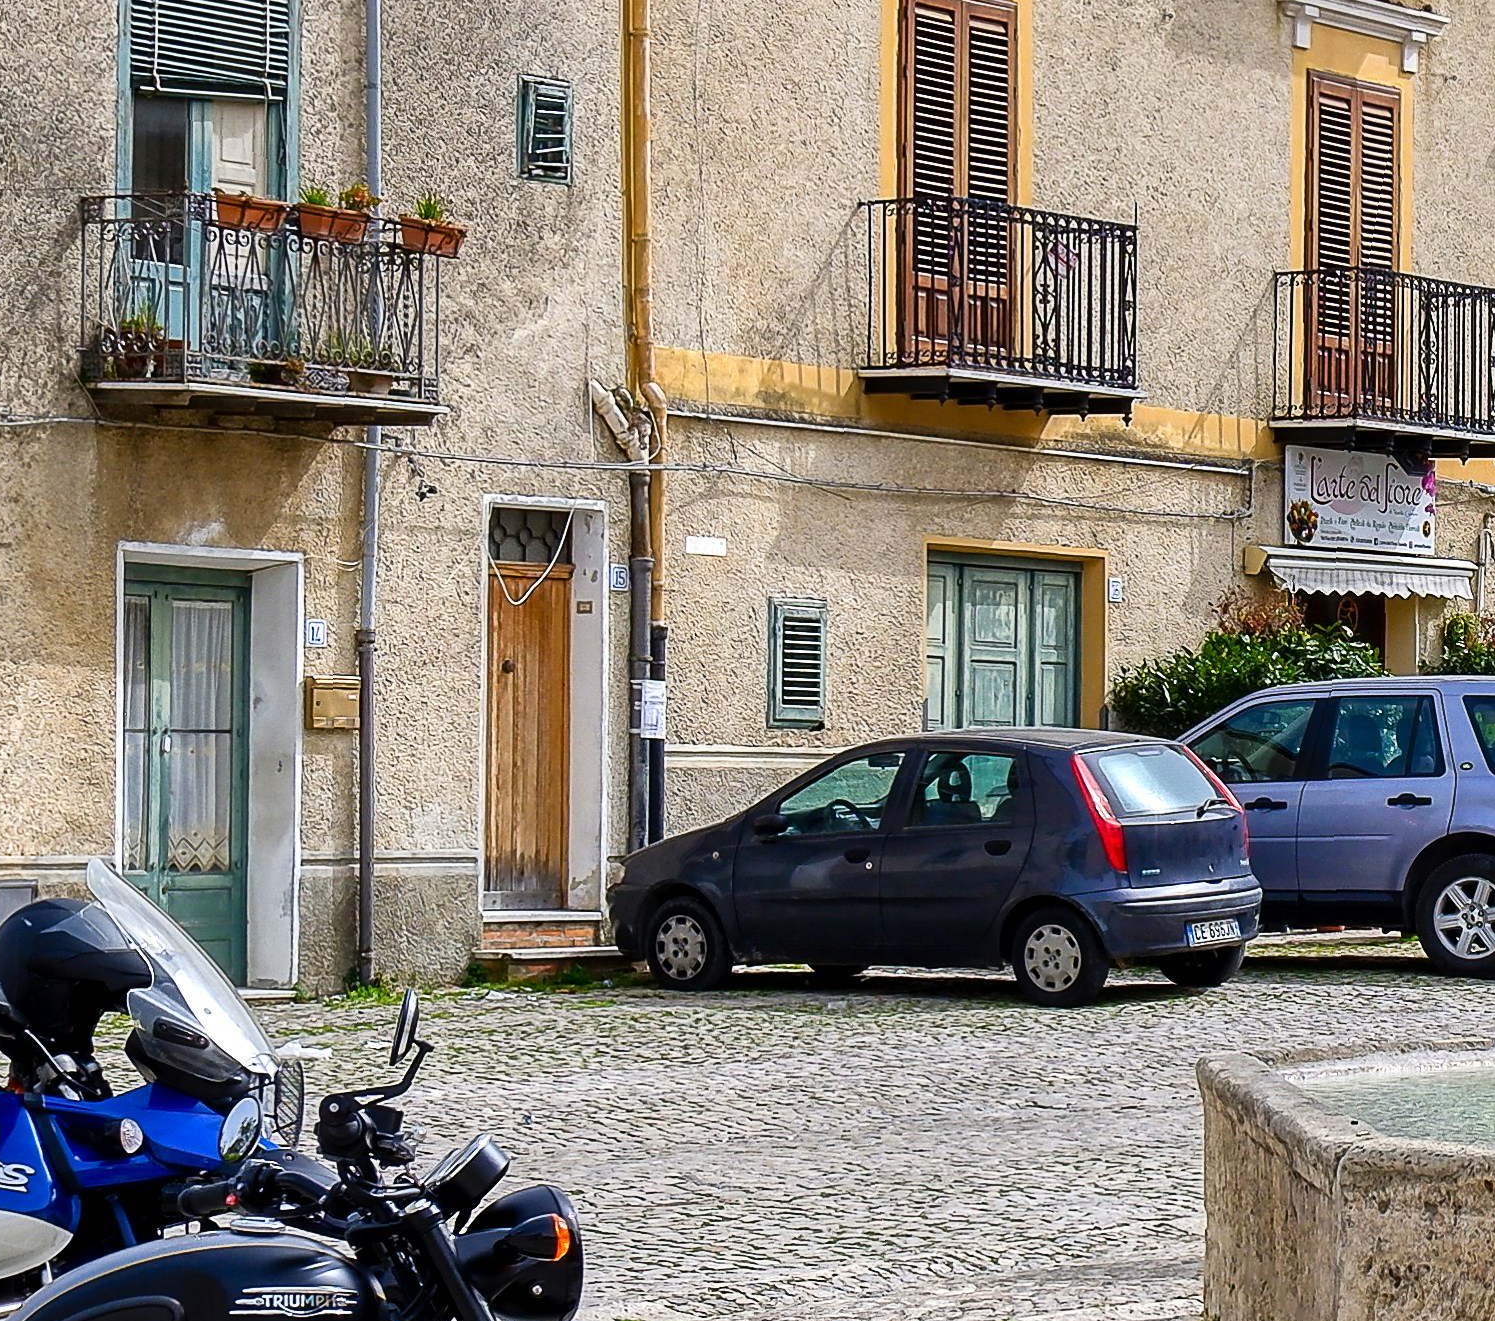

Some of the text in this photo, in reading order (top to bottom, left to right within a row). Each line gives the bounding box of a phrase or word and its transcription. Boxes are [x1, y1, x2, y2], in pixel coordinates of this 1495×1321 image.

[1360, 474, 1381, 505] del
[615, 570, 626, 586] 15
[1194, 924, 1208, 940] CE
[261, 1294, 337, 1308] TRIUMPH
